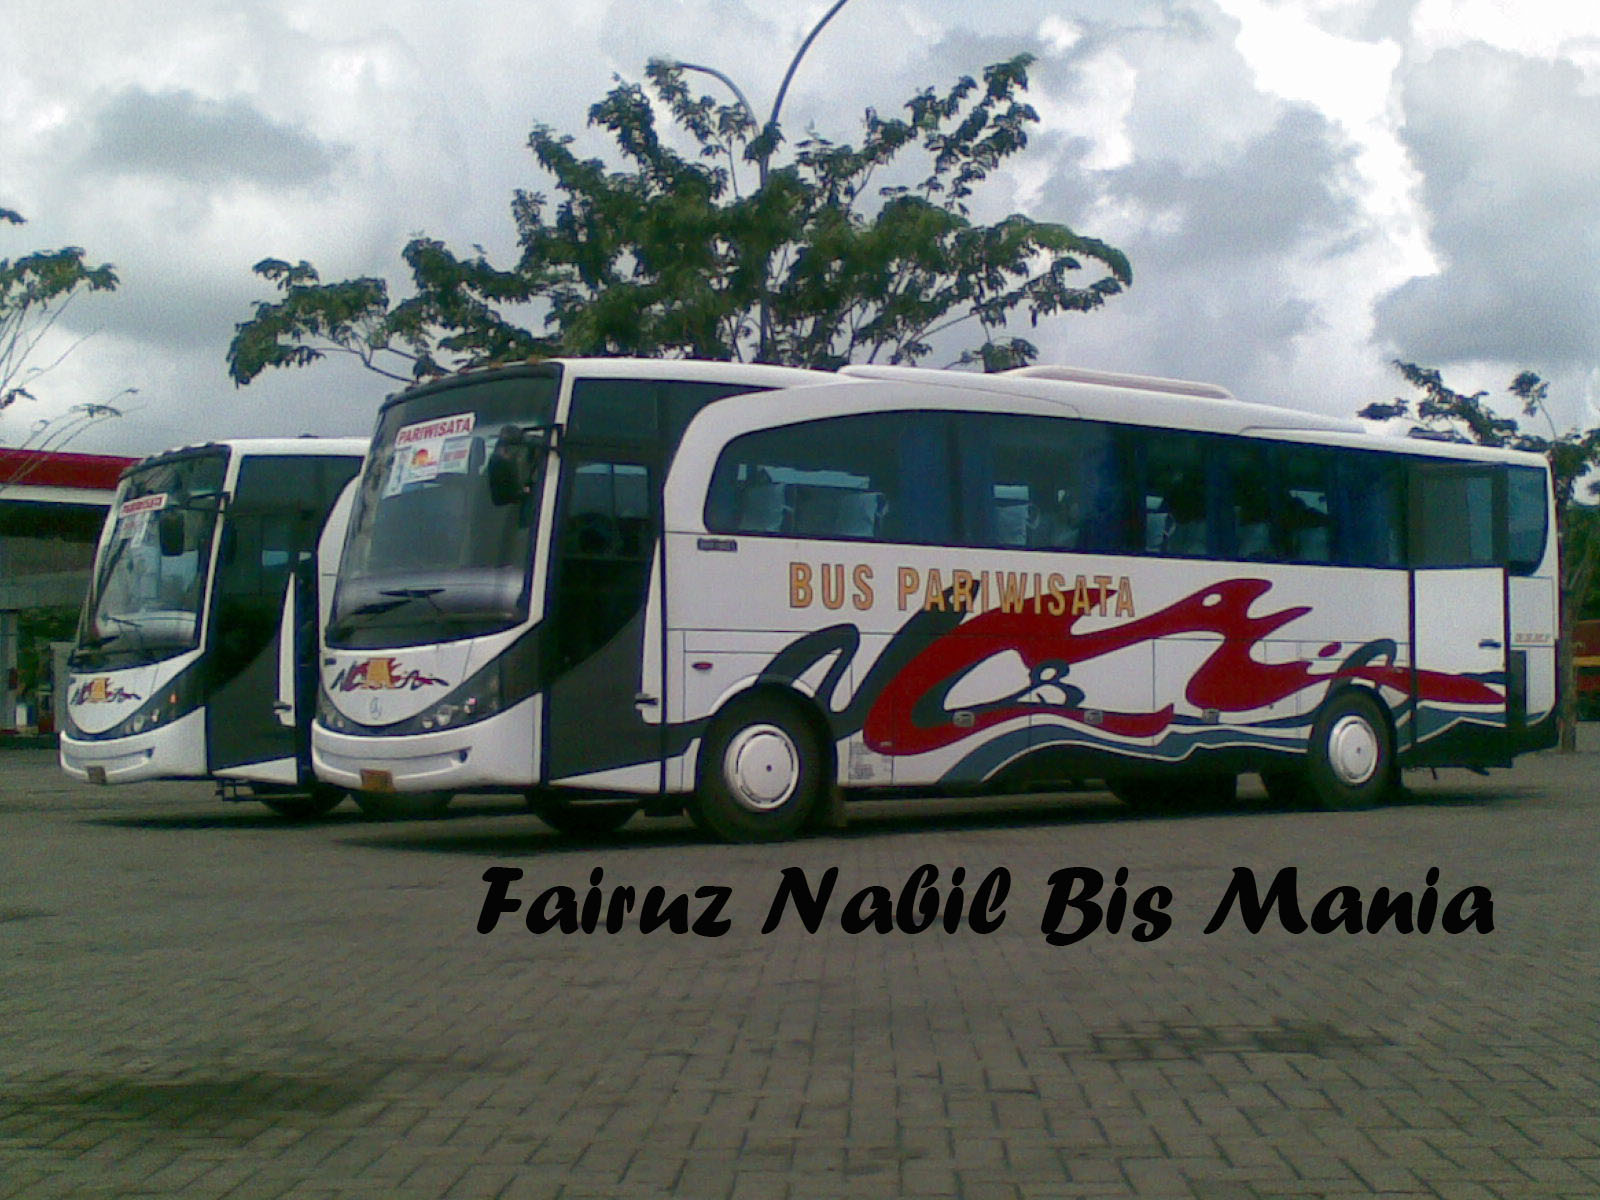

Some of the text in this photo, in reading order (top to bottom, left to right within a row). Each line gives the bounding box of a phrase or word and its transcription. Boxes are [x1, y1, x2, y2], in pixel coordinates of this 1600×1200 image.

[398, 417, 472, 445] PARIWISATA
[789, 561, 1136, 618] BUS PARIWISATA
